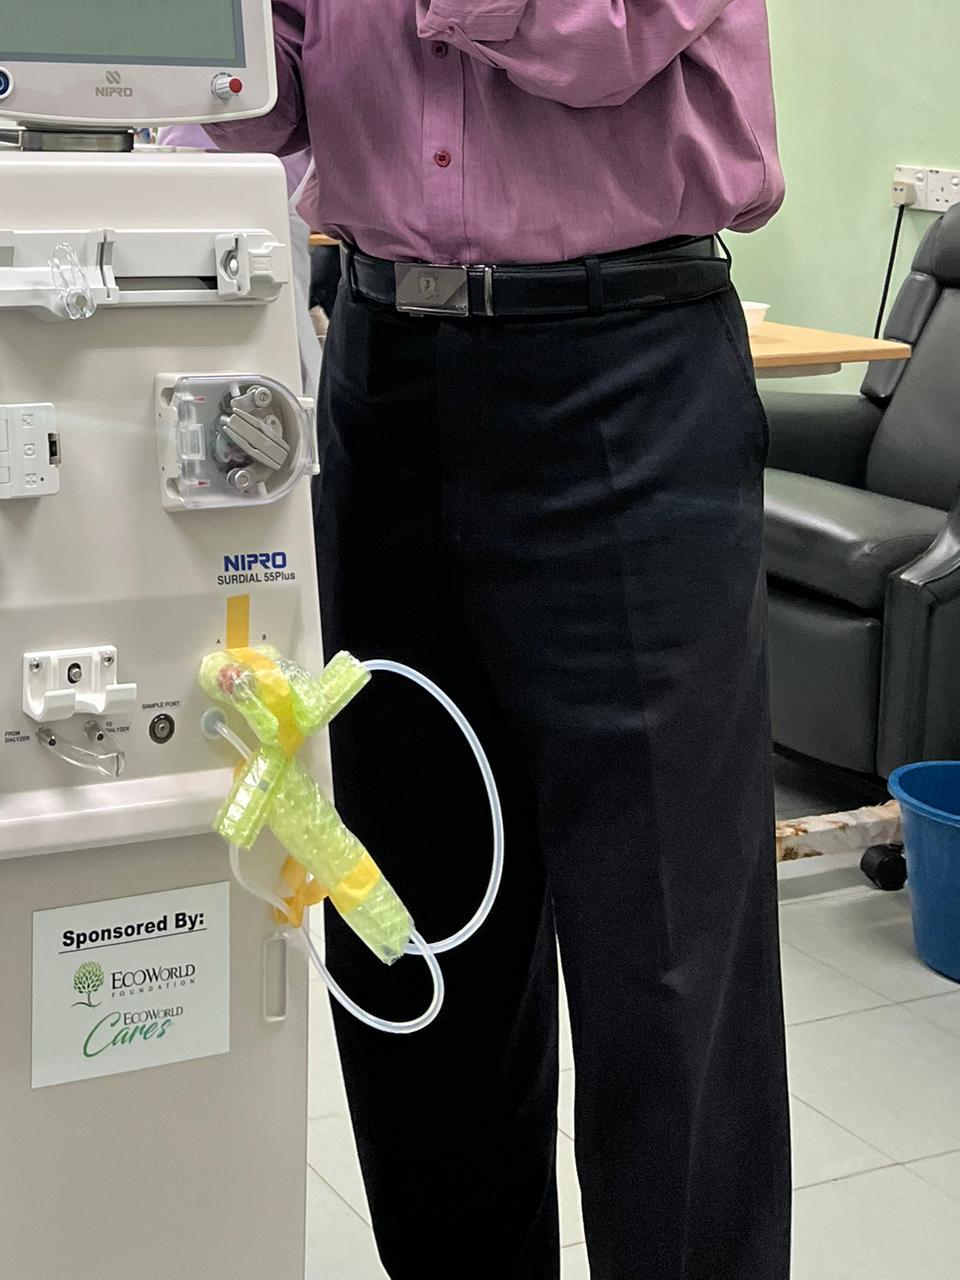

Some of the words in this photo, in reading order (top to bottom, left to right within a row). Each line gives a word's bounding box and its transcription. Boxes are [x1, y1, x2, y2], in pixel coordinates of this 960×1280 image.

[95, 86, 133, 97] NIPRO
[223, 551, 287, 572] NIPRO
[217, 573, 262, 585] SURDIAL
[263, 571, 296, 582] 55Plus
[62, 915, 168, 949] Sponsored
[174, 912, 205, 931] By:
[111, 979, 196, 998] FOUNDATION
[83, 1011, 173, 1058] Cares
